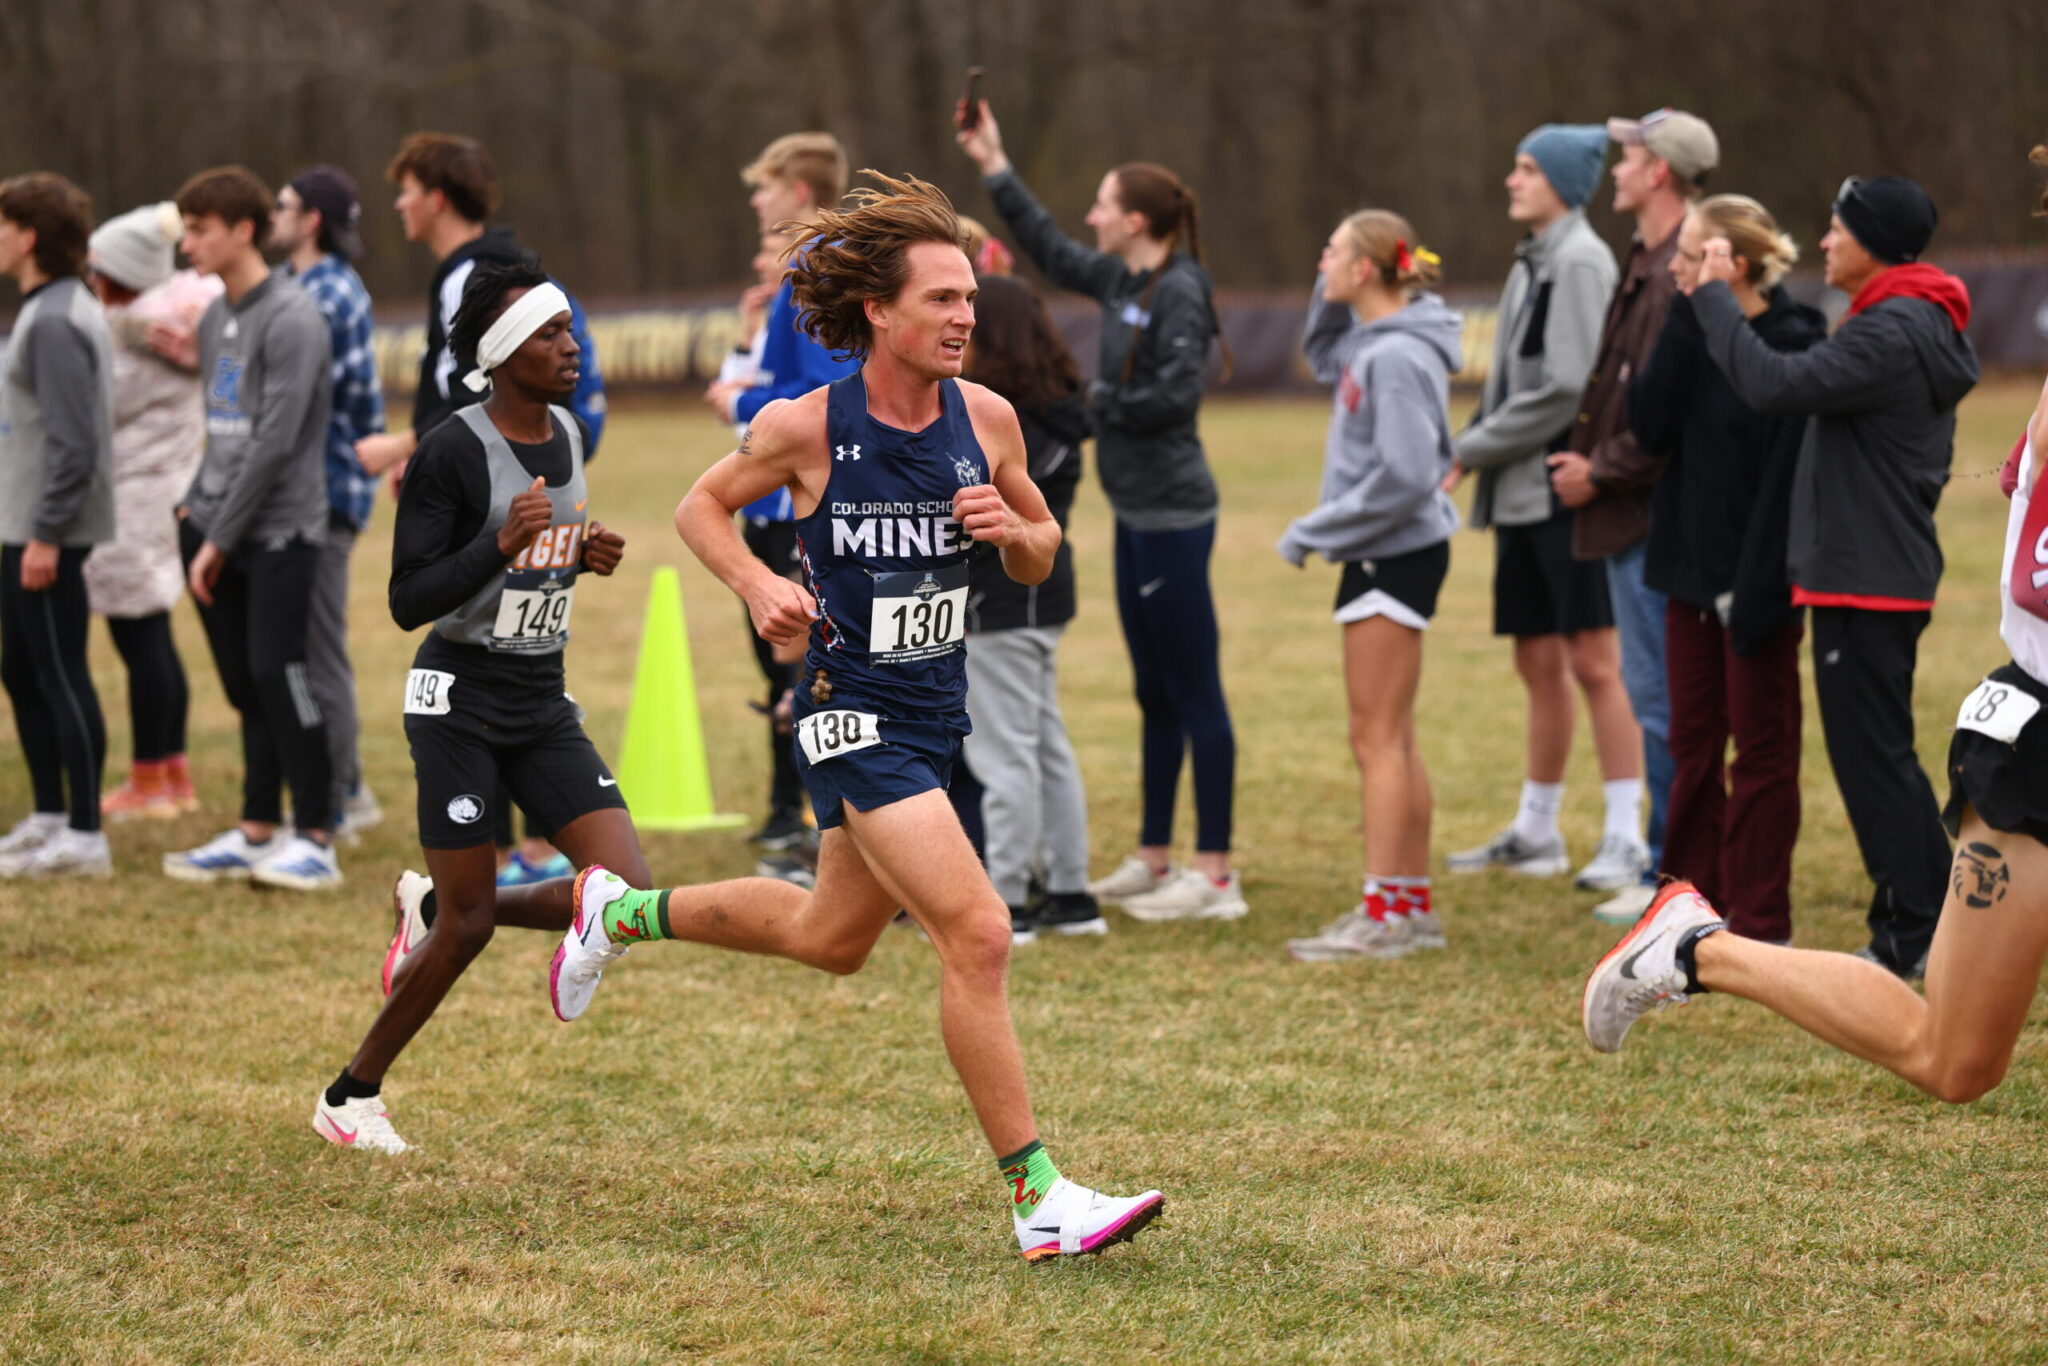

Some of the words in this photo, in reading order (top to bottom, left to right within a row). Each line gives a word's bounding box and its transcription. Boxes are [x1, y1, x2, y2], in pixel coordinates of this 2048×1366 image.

[831, 502, 913, 515] COLORADO
[917, 501, 954, 514] SCHO
[512, 596, 567, 637] 149
[891, 598, 953, 651] 130
[410, 672, 439, 707] 149
[811, 713, 861, 754] 130
